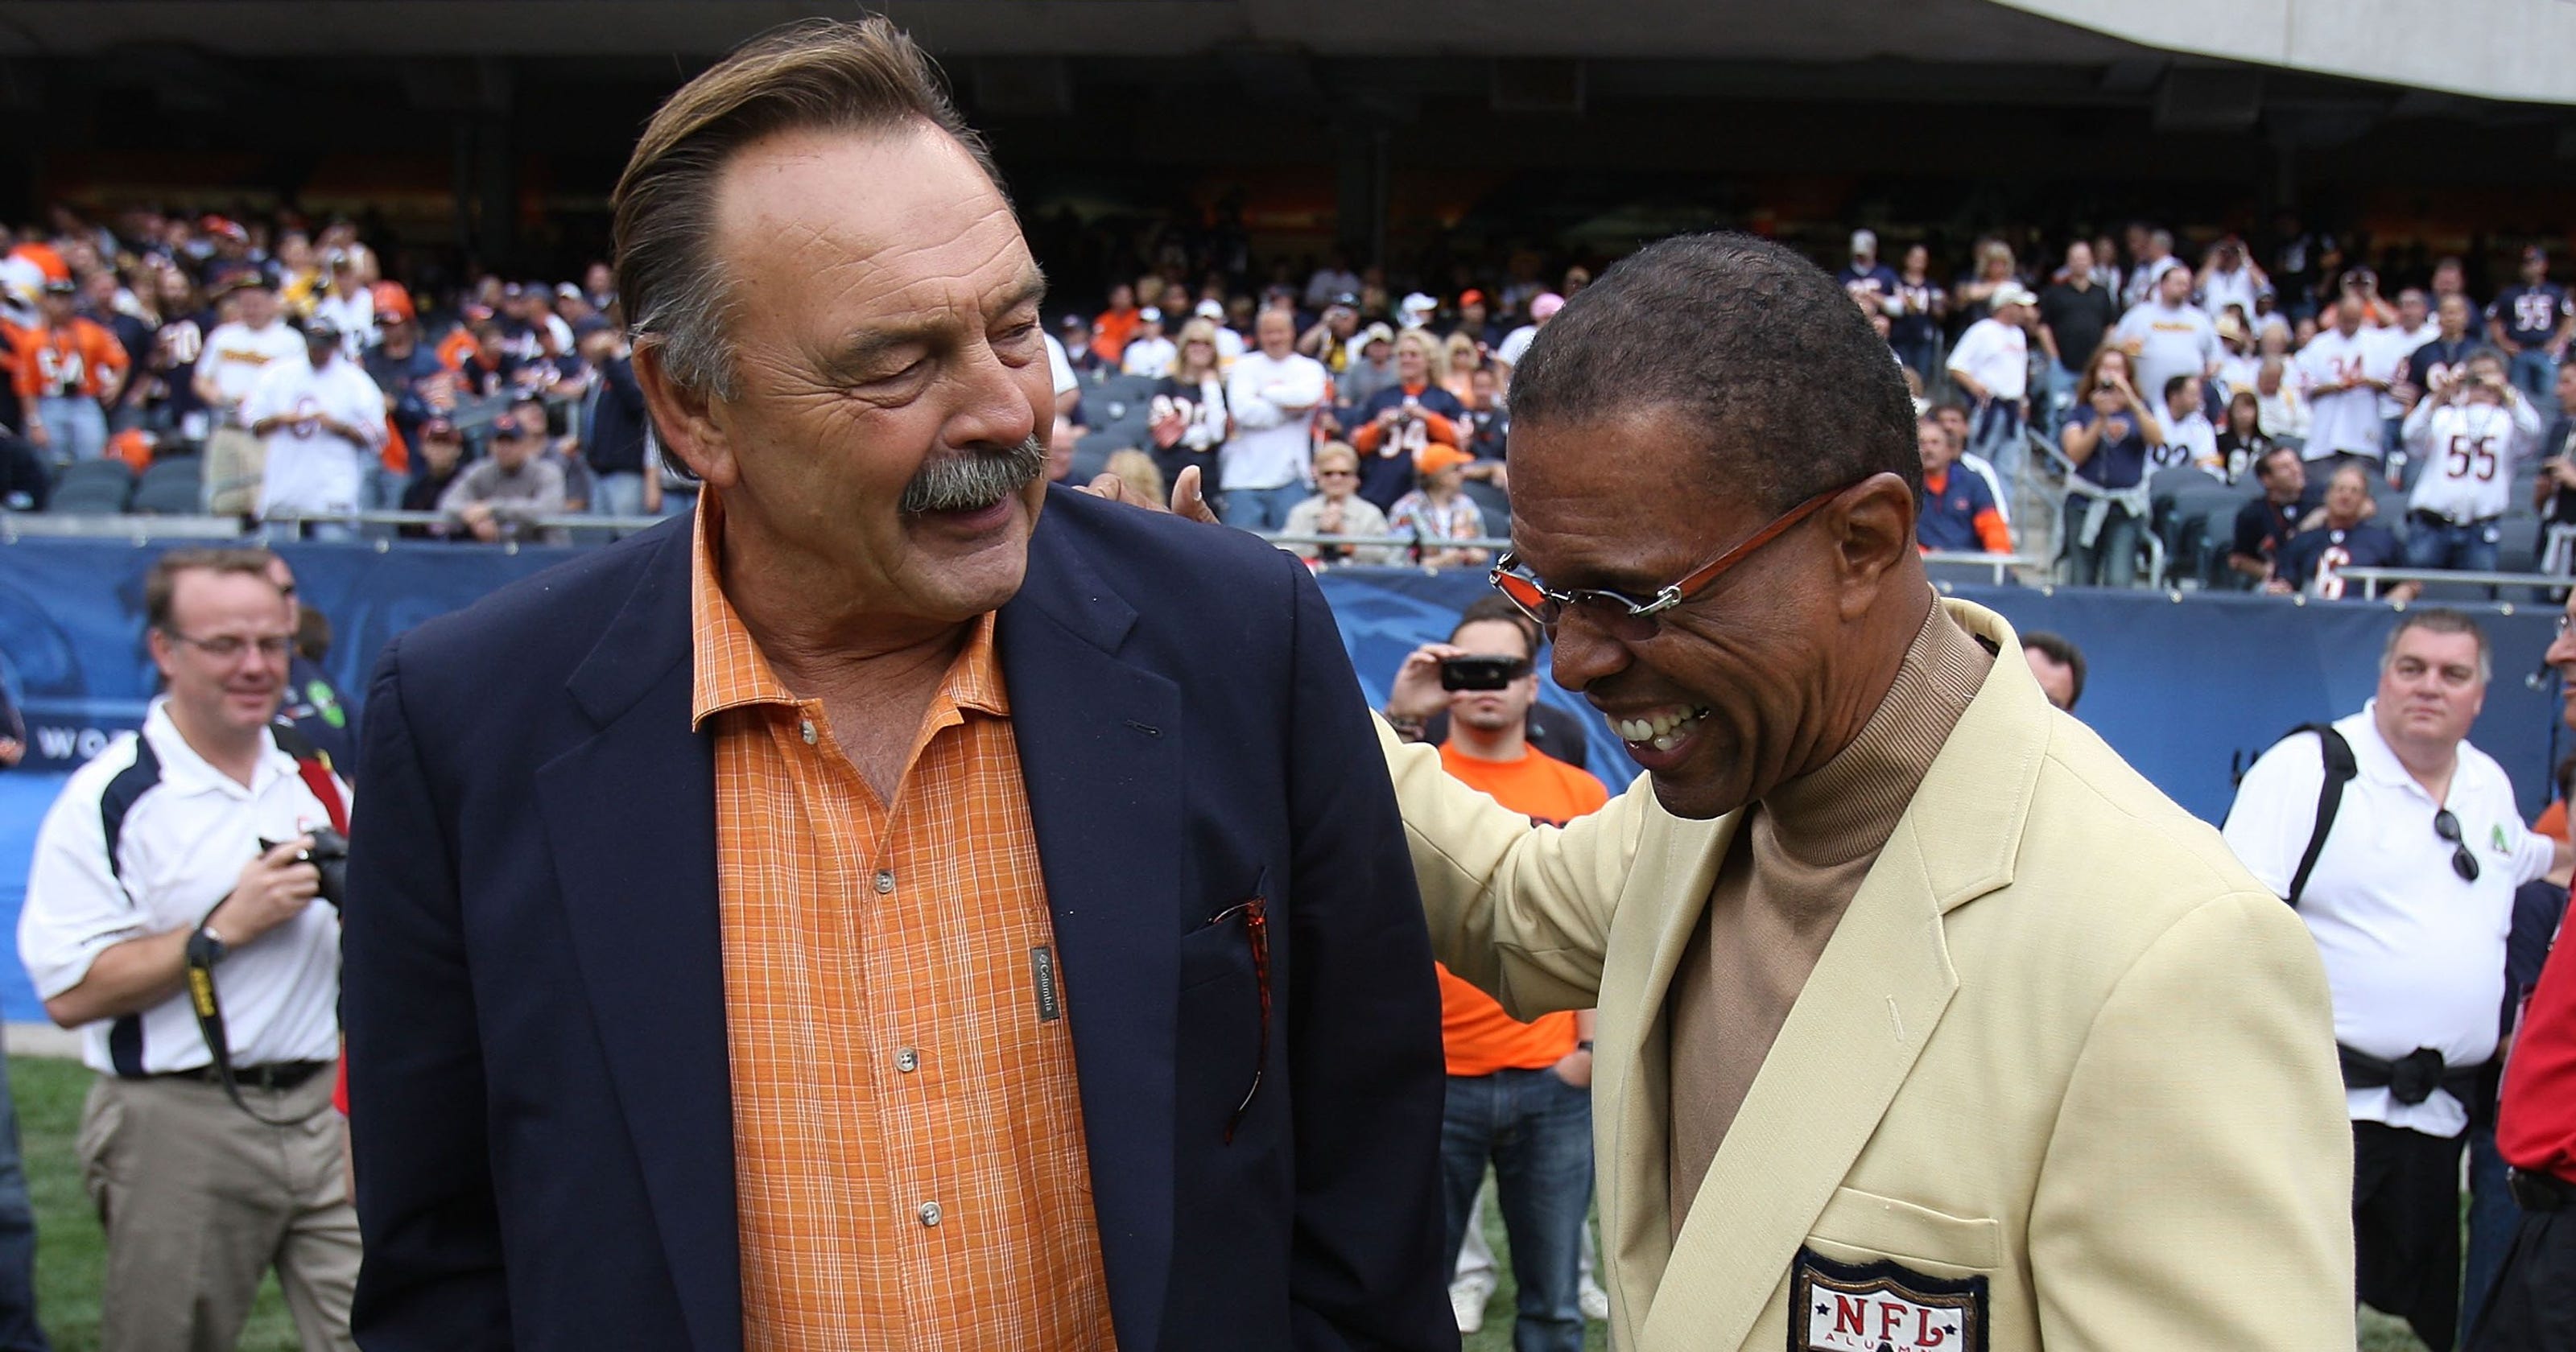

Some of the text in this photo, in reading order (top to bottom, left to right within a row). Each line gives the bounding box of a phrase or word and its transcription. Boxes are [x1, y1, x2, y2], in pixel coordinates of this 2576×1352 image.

[2514, 295, 2553, 332] 55
[2447, 435, 2496, 480] 55
[37, 726, 121, 760] WO
[1040, 964, 1053, 1012] Columbia
[1833, 1294, 1944, 1347] NFL
